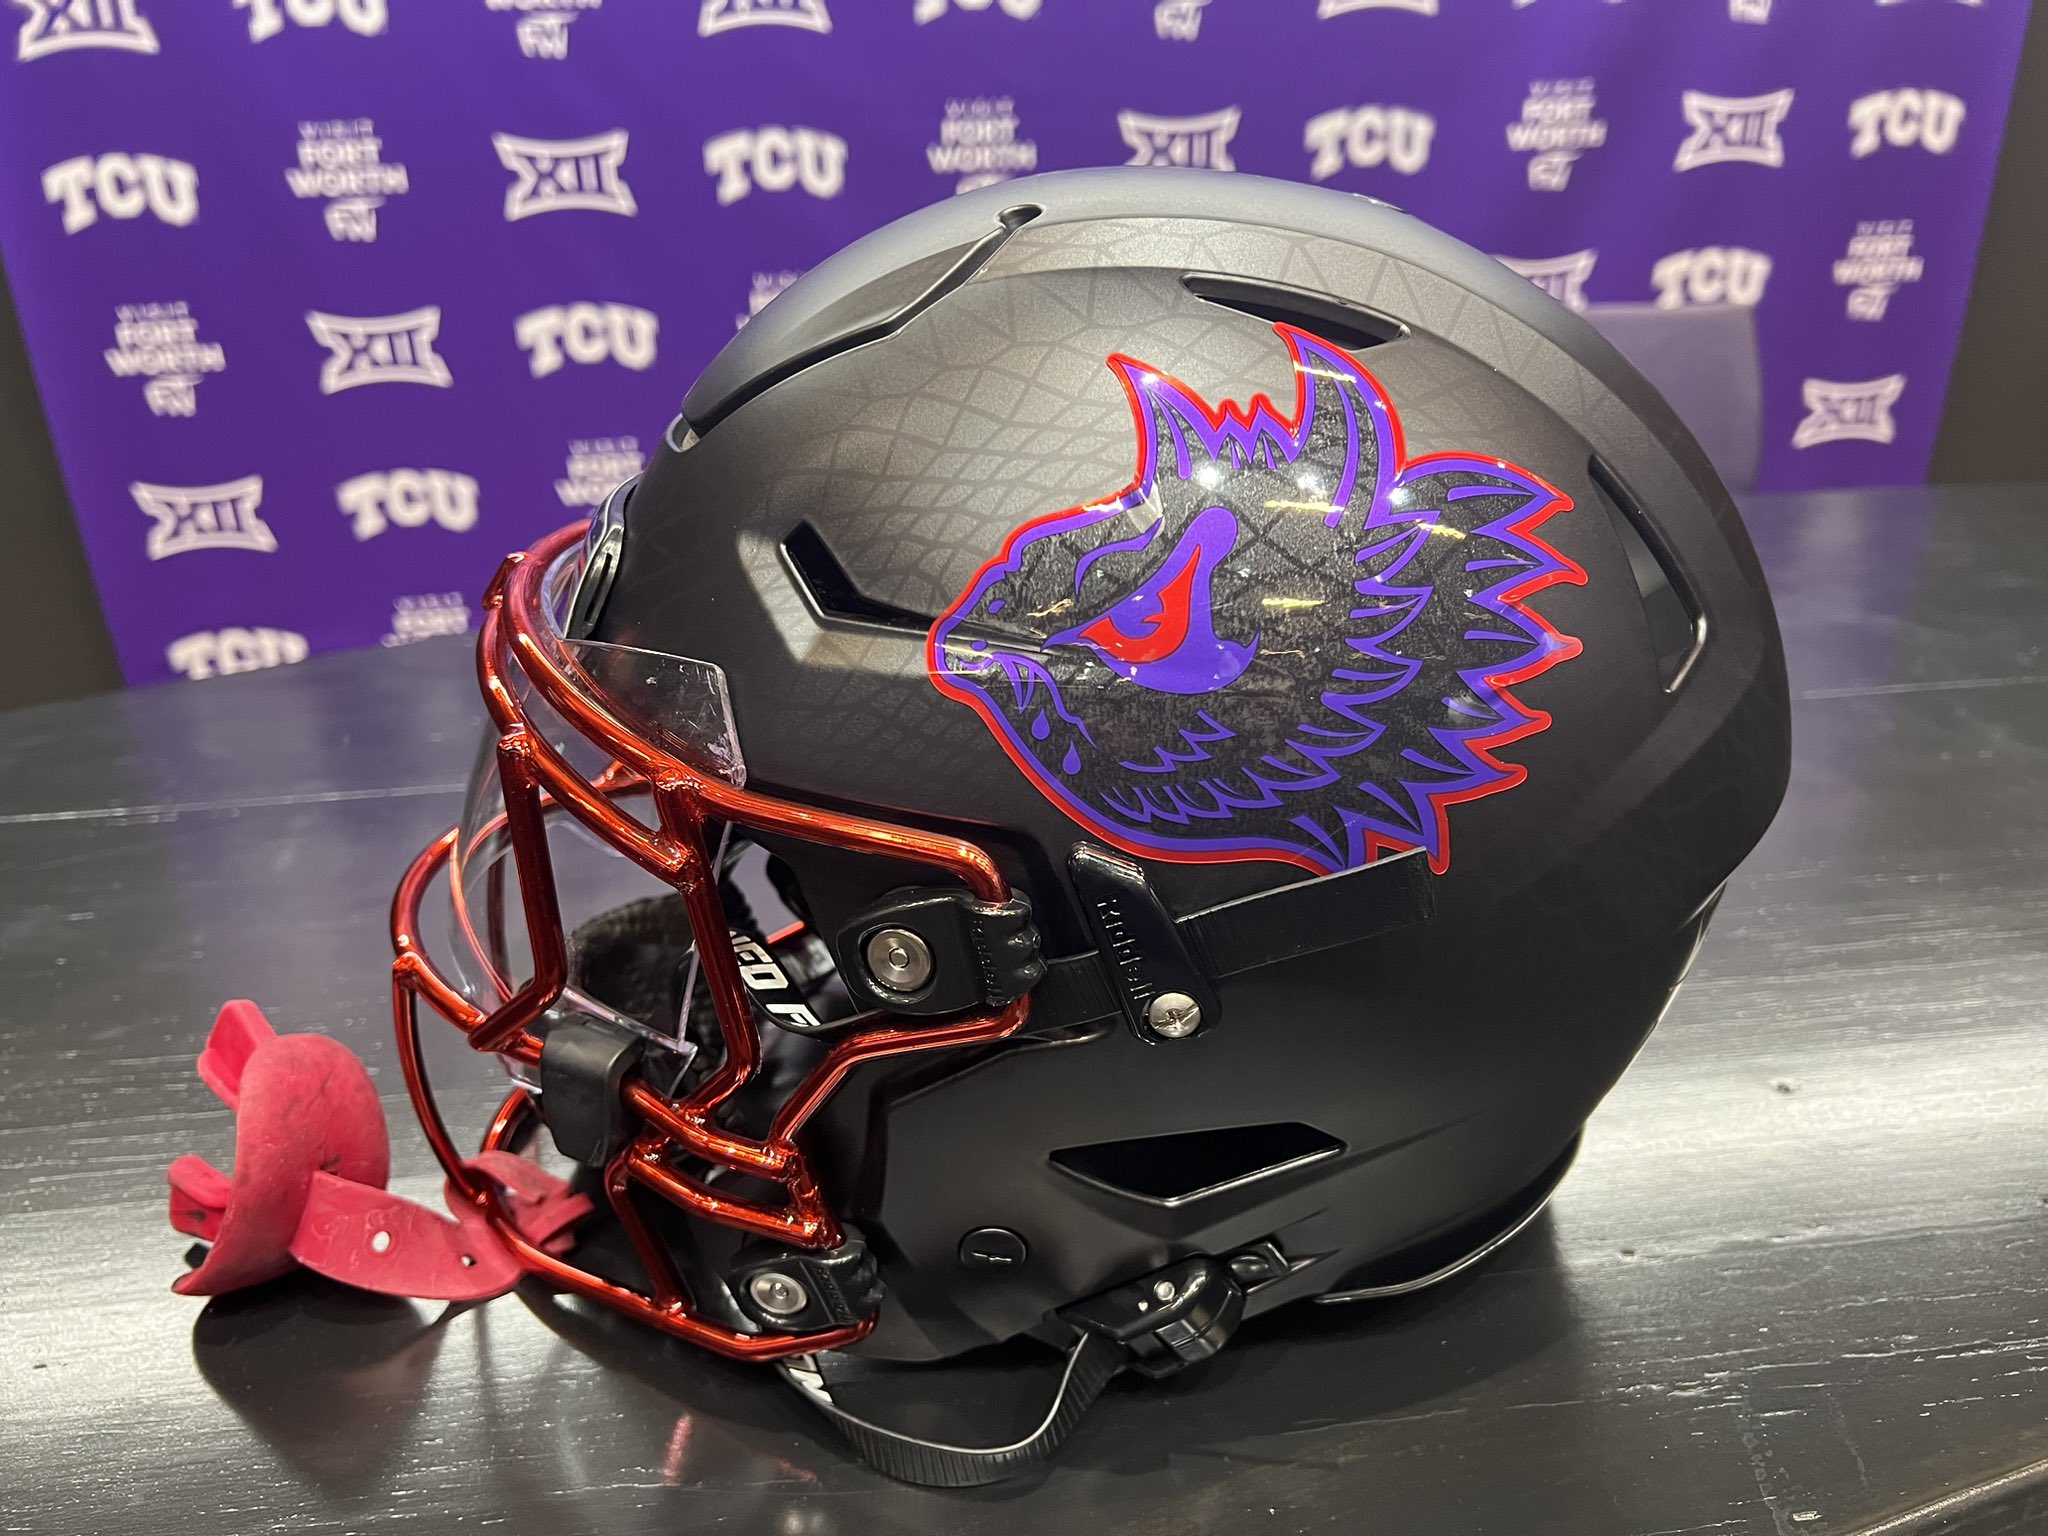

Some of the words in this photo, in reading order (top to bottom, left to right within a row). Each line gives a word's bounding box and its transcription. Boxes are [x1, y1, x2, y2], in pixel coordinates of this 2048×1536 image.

[1304, 105, 1436, 181] TCU
[1847, 87, 1966, 159] TCU
[41, 152, 199, 235] TCU
[703, 125, 848, 205] TCU
[1651, 245, 1772, 309] TCU
[515, 302, 658, 378] TCU
[336, 468, 480, 541] TCU
[1096, 897, 1157, 1001] Riddell
